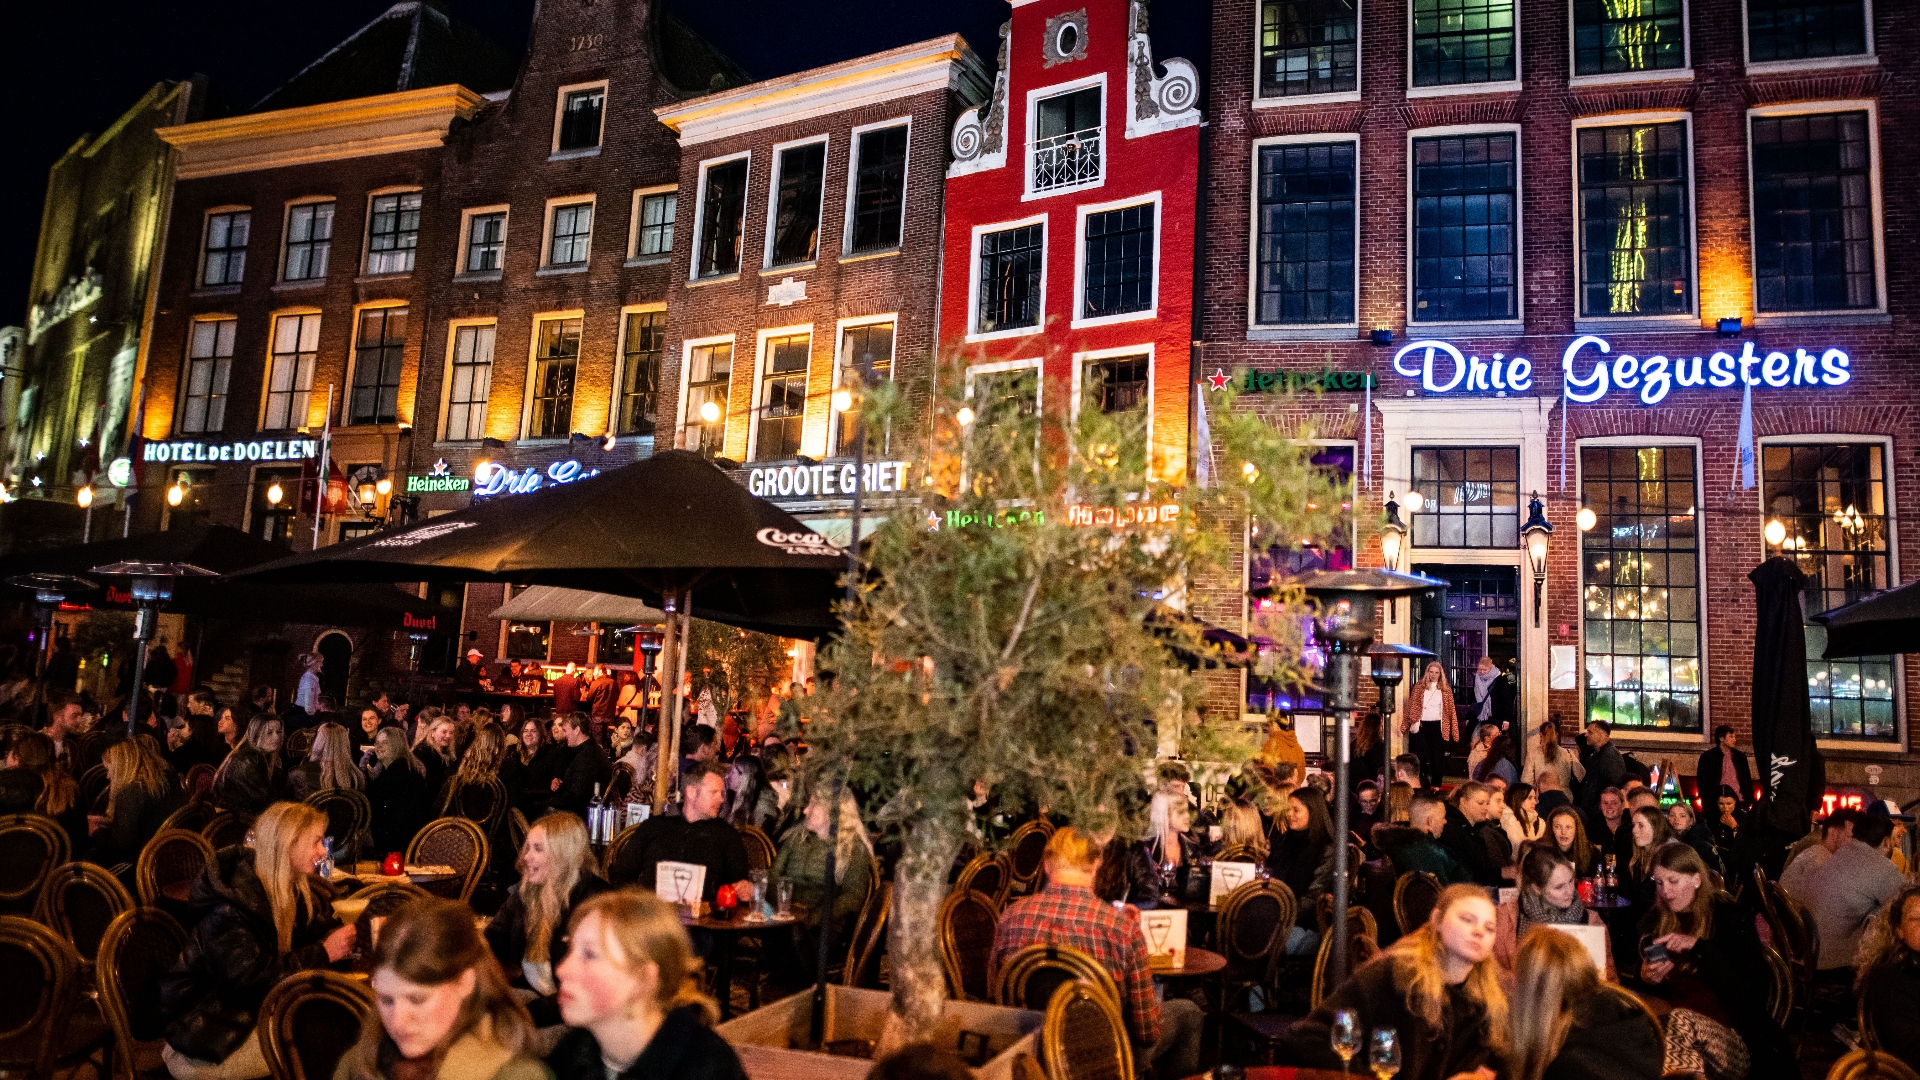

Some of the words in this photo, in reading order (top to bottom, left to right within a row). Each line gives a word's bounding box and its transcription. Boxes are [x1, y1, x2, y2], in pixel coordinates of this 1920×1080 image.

[1393, 340, 1533, 393] Drie
[1562, 335, 1851, 404] Gezusters
[143, 442, 206, 461] HOTEL
[233, 440, 316, 461] DOELEN
[407, 476, 470, 492] Heineken
[474, 461, 544, 496] Drie
[750, 465, 836, 496] GROOTE
[839, 462, 907, 493] GRIET
[403, 611, 436, 629] Duvel
